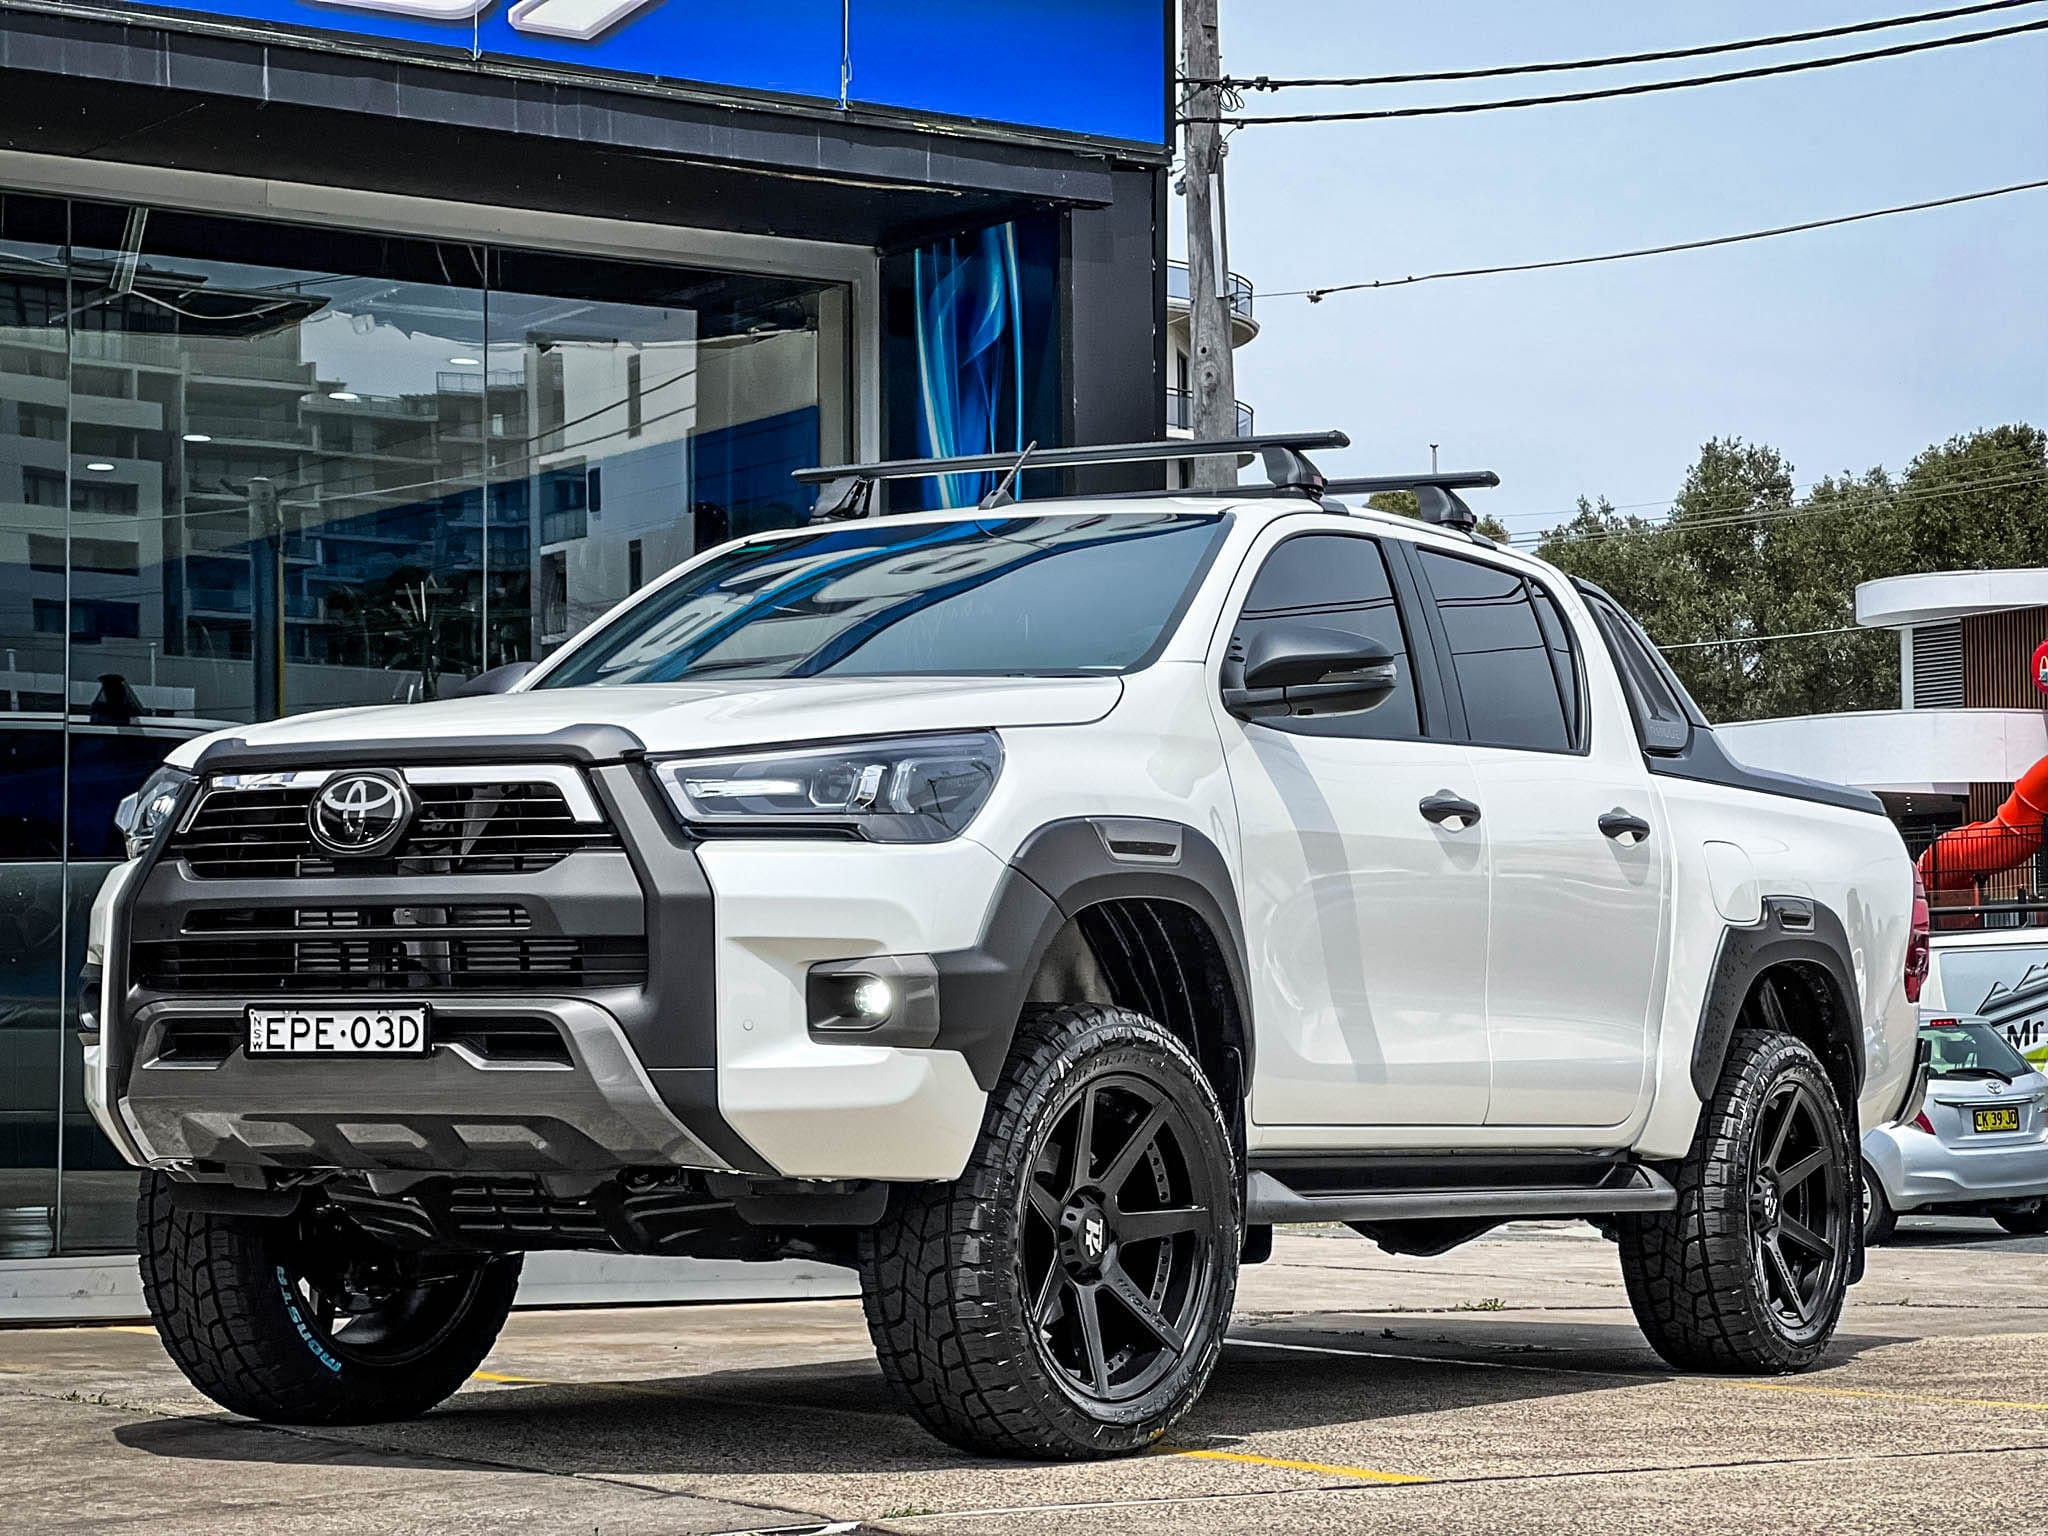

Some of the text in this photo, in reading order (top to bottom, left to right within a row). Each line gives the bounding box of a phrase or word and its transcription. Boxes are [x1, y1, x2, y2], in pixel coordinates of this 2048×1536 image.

[252, 1016, 264, 1050] NSW
[2007, 1019, 2044, 1049] Mr
[1991, 1111, 2003, 1126] 39
